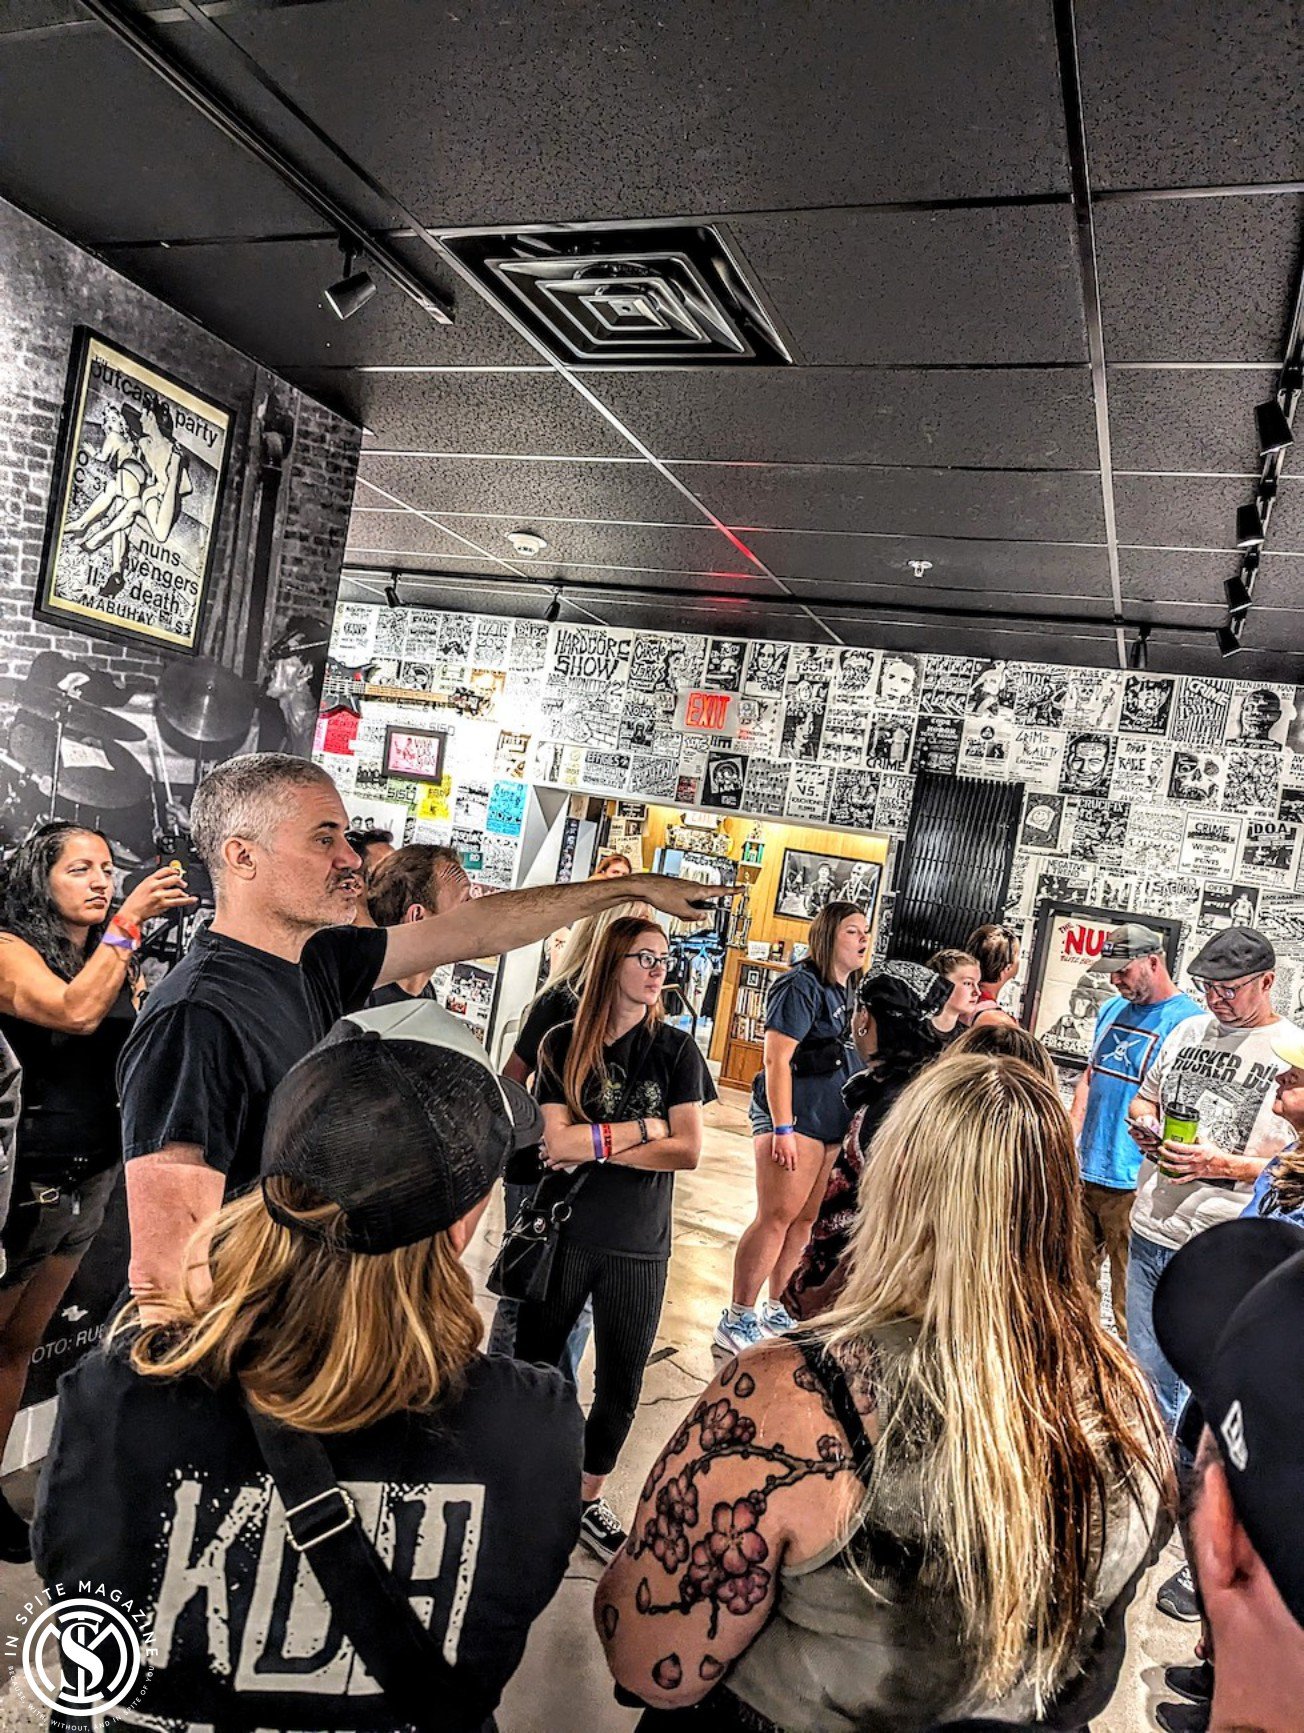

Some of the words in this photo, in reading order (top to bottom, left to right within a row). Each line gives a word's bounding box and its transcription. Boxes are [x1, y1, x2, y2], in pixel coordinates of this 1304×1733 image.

[175, 409, 217, 448] party
[140, 540, 181, 566] nuns
[80, 594, 154, 626] MABUHAY
[130, 582, 179, 614] death
[554, 629, 632, 662] HARDCORE
[554, 655, 620, 680] SHOW
[1188, 679, 1231, 706] CRIME
[685, 692, 732, 730] EXIT
[867, 759, 906, 772] CRIME
[1195, 822, 1230, 836] CRIME
[1064, 924, 1112, 957] NU
